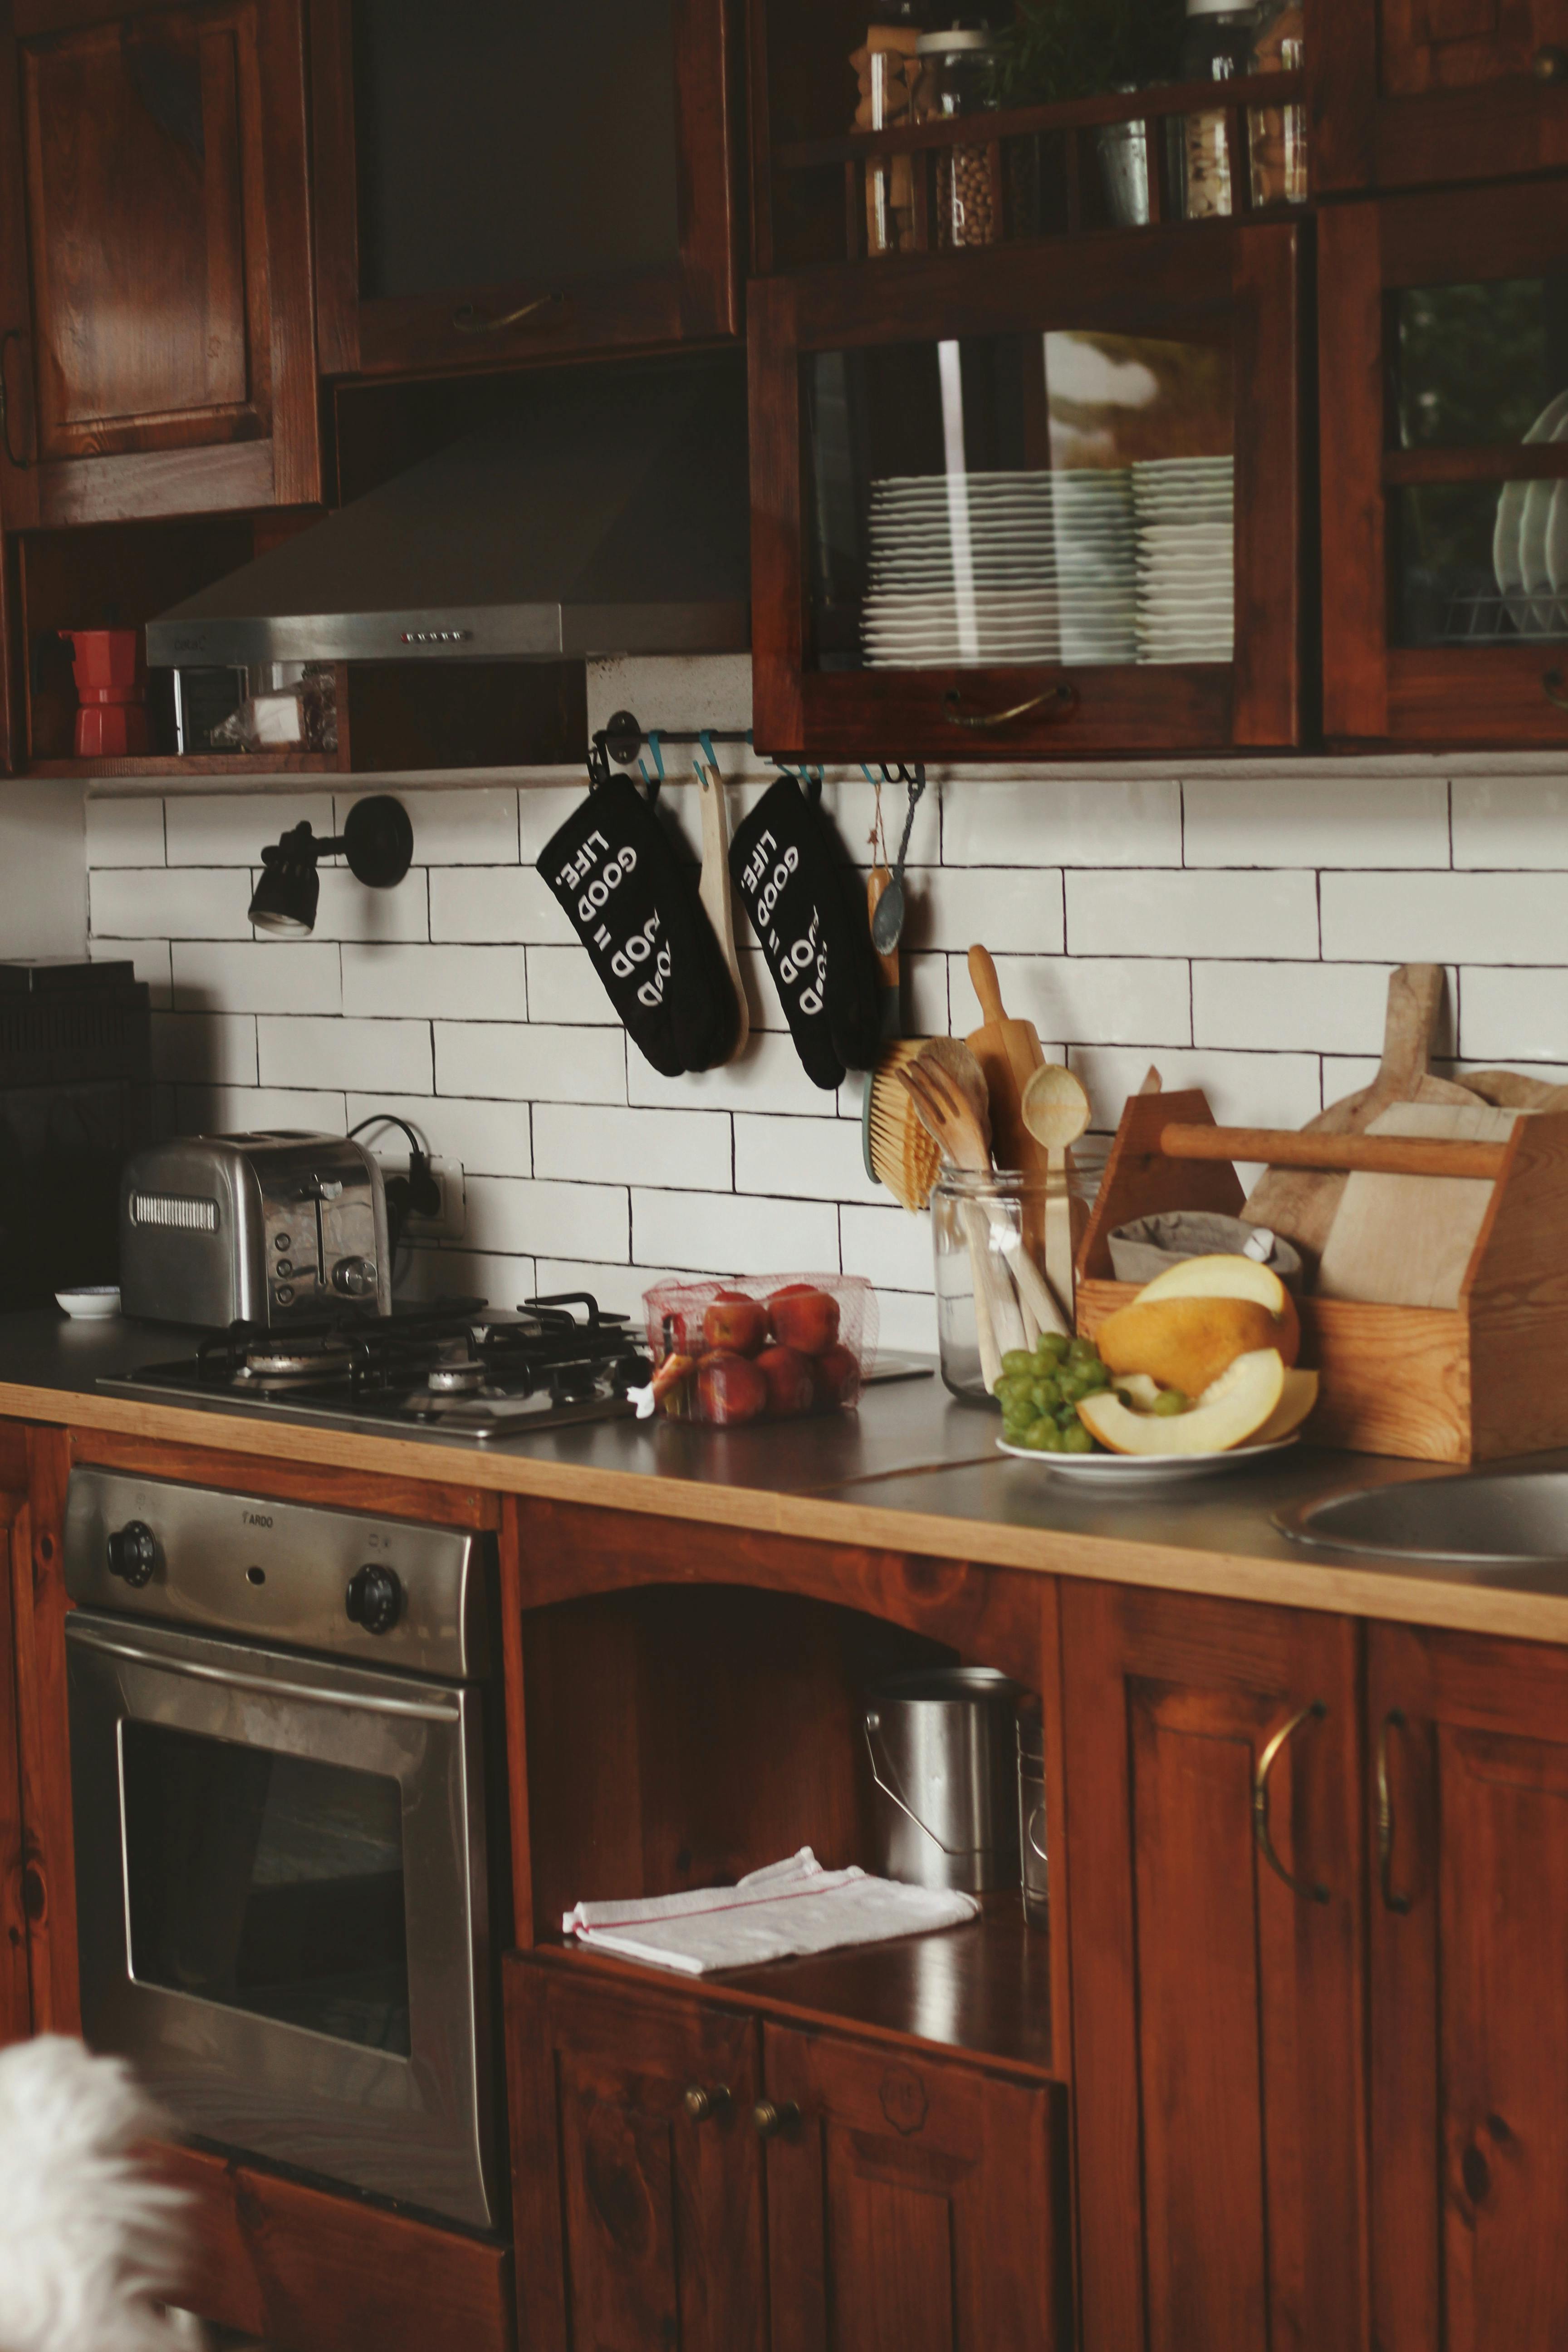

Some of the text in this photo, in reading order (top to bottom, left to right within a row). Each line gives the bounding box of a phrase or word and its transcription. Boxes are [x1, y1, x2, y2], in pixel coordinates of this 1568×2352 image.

[556, 830, 609, 891] LIFE.
[578, 846, 637, 922] GOOD
[741, 829, 777, 894] LIFE.
[757, 846, 799, 927] GOOD
[612, 907, 661, 978] OOD
[637, 939, 671, 1006] OOD
[799, 940, 827, 1015] OOD
